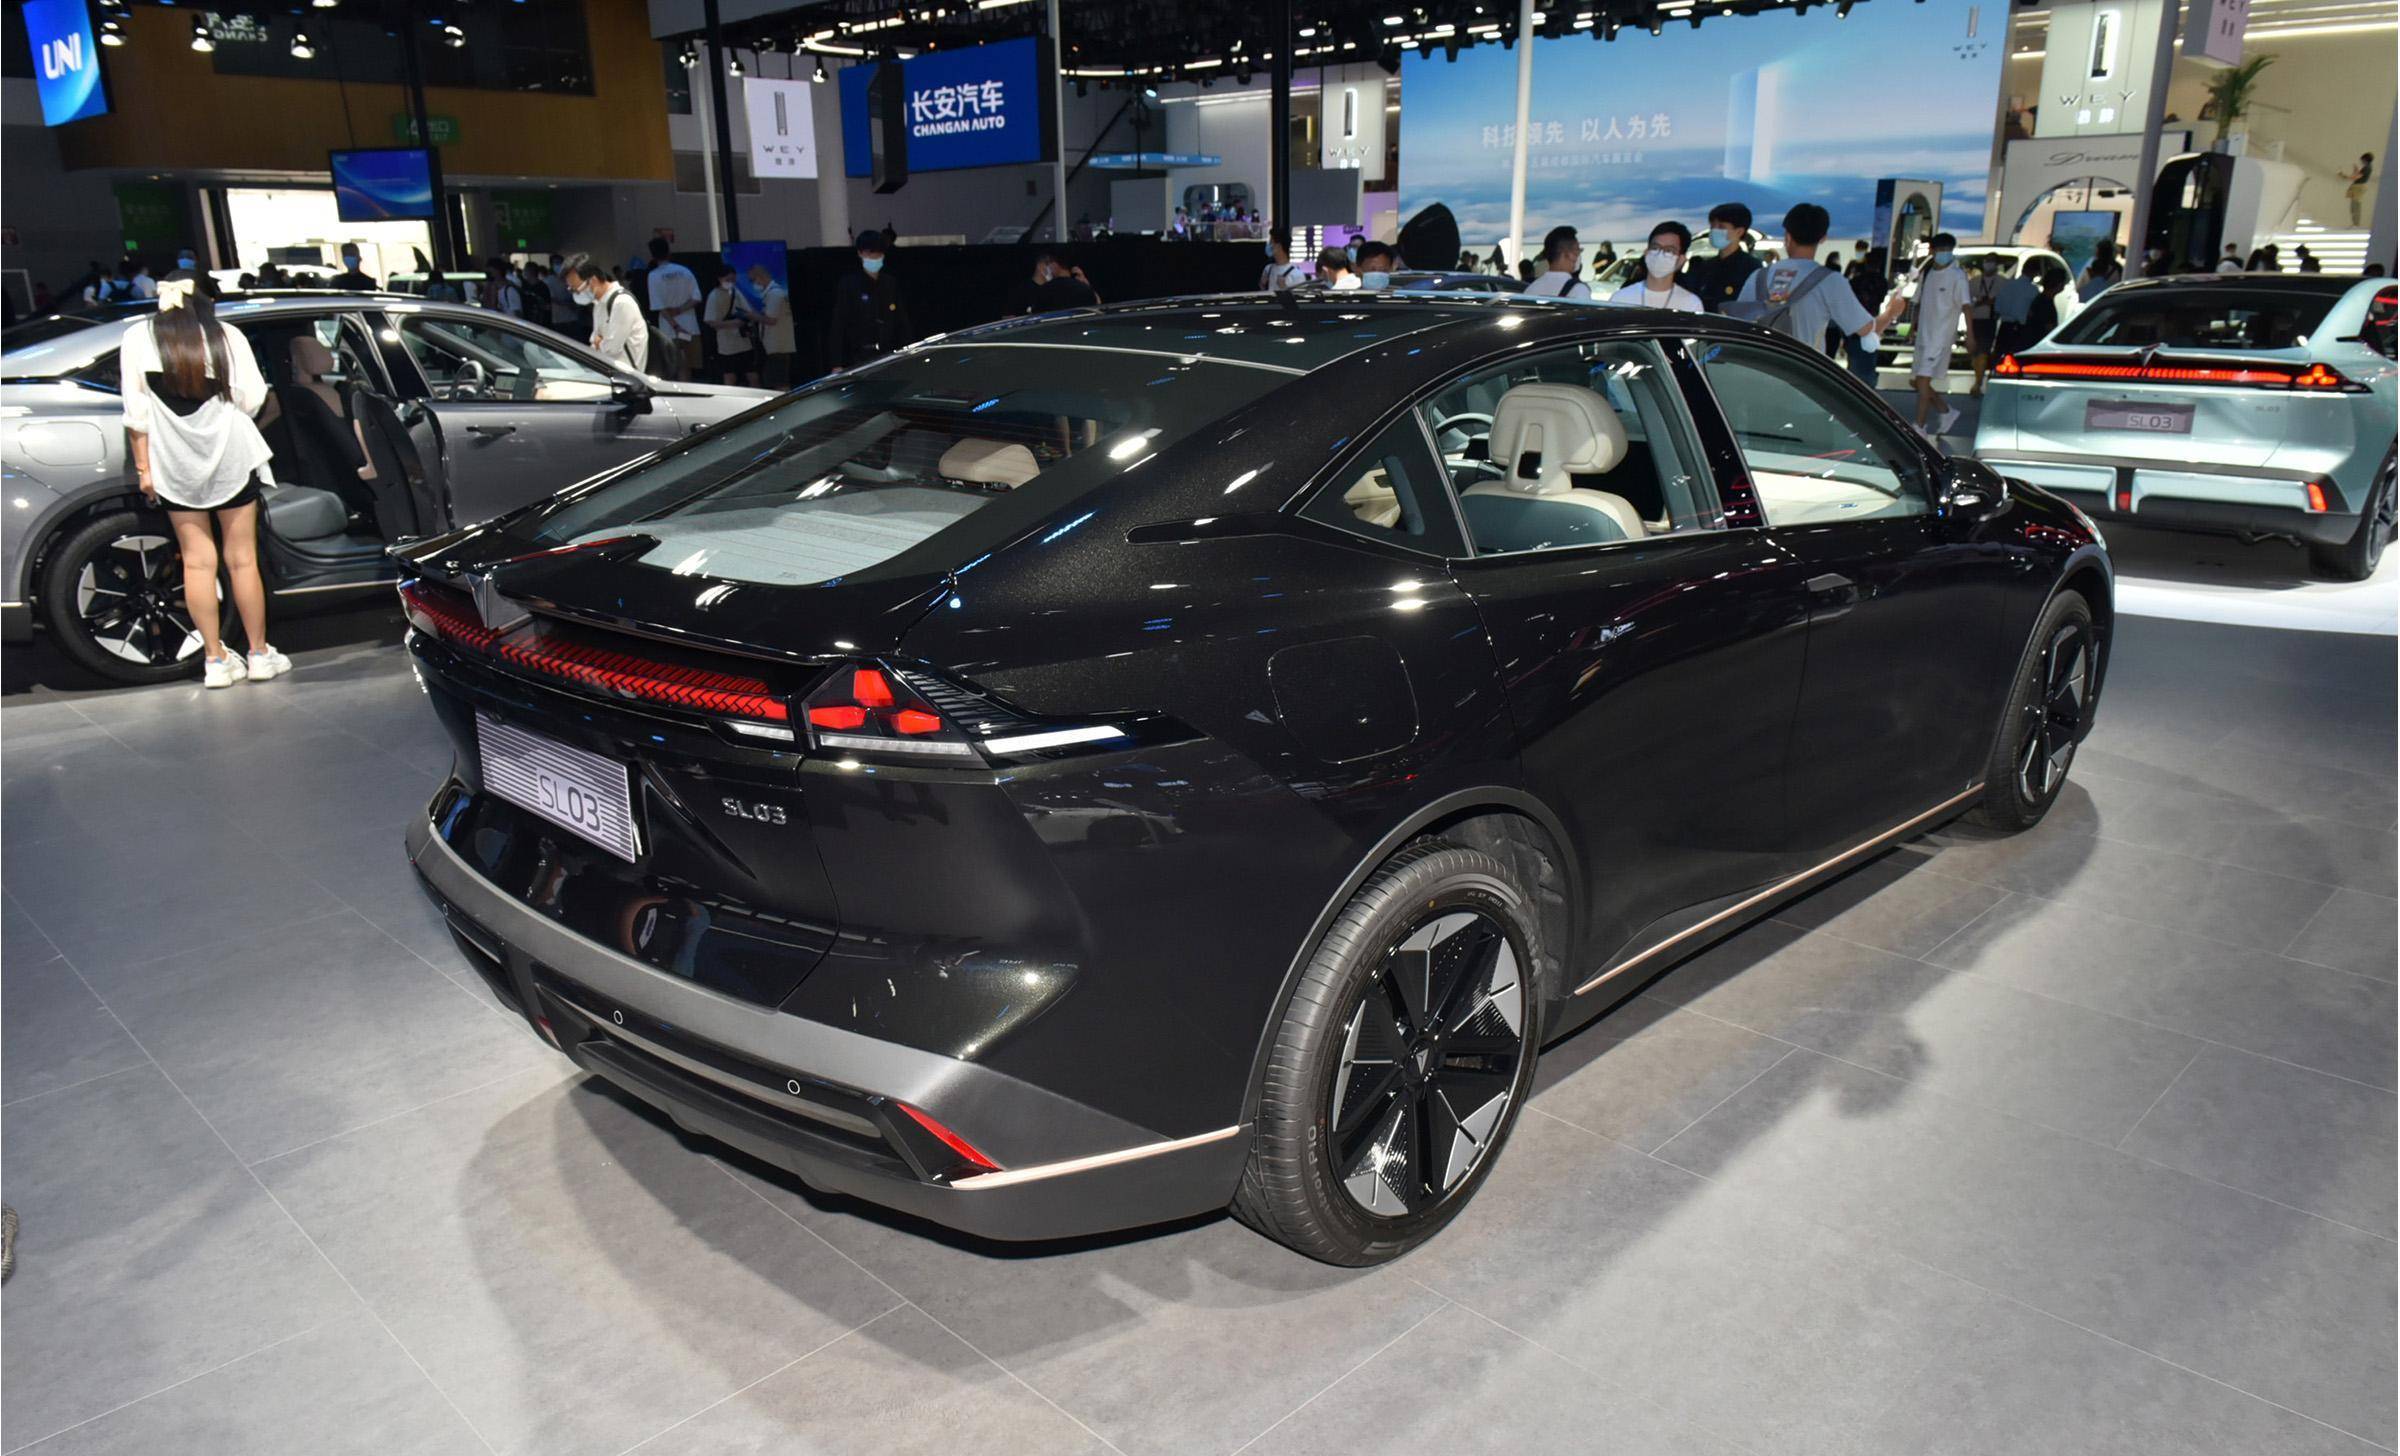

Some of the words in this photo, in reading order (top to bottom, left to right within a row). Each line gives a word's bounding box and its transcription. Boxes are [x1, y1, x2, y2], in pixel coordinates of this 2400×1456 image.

[42, 32, 83, 80] UNI
[912, 80, 1004, 122] 长安汽车
[2059, 90, 2137, 107] WEY
[913, 119, 970, 137] CHANGAN
[972, 115, 1005, 131] AUTO
[1581, 112, 1672, 142] 以人为先
[762, 144, 805, 154] WEY
[2129, 414, 2173, 429] SL03
[539, 774, 602, 833] SL03
[721, 798, 788, 826] SL03
